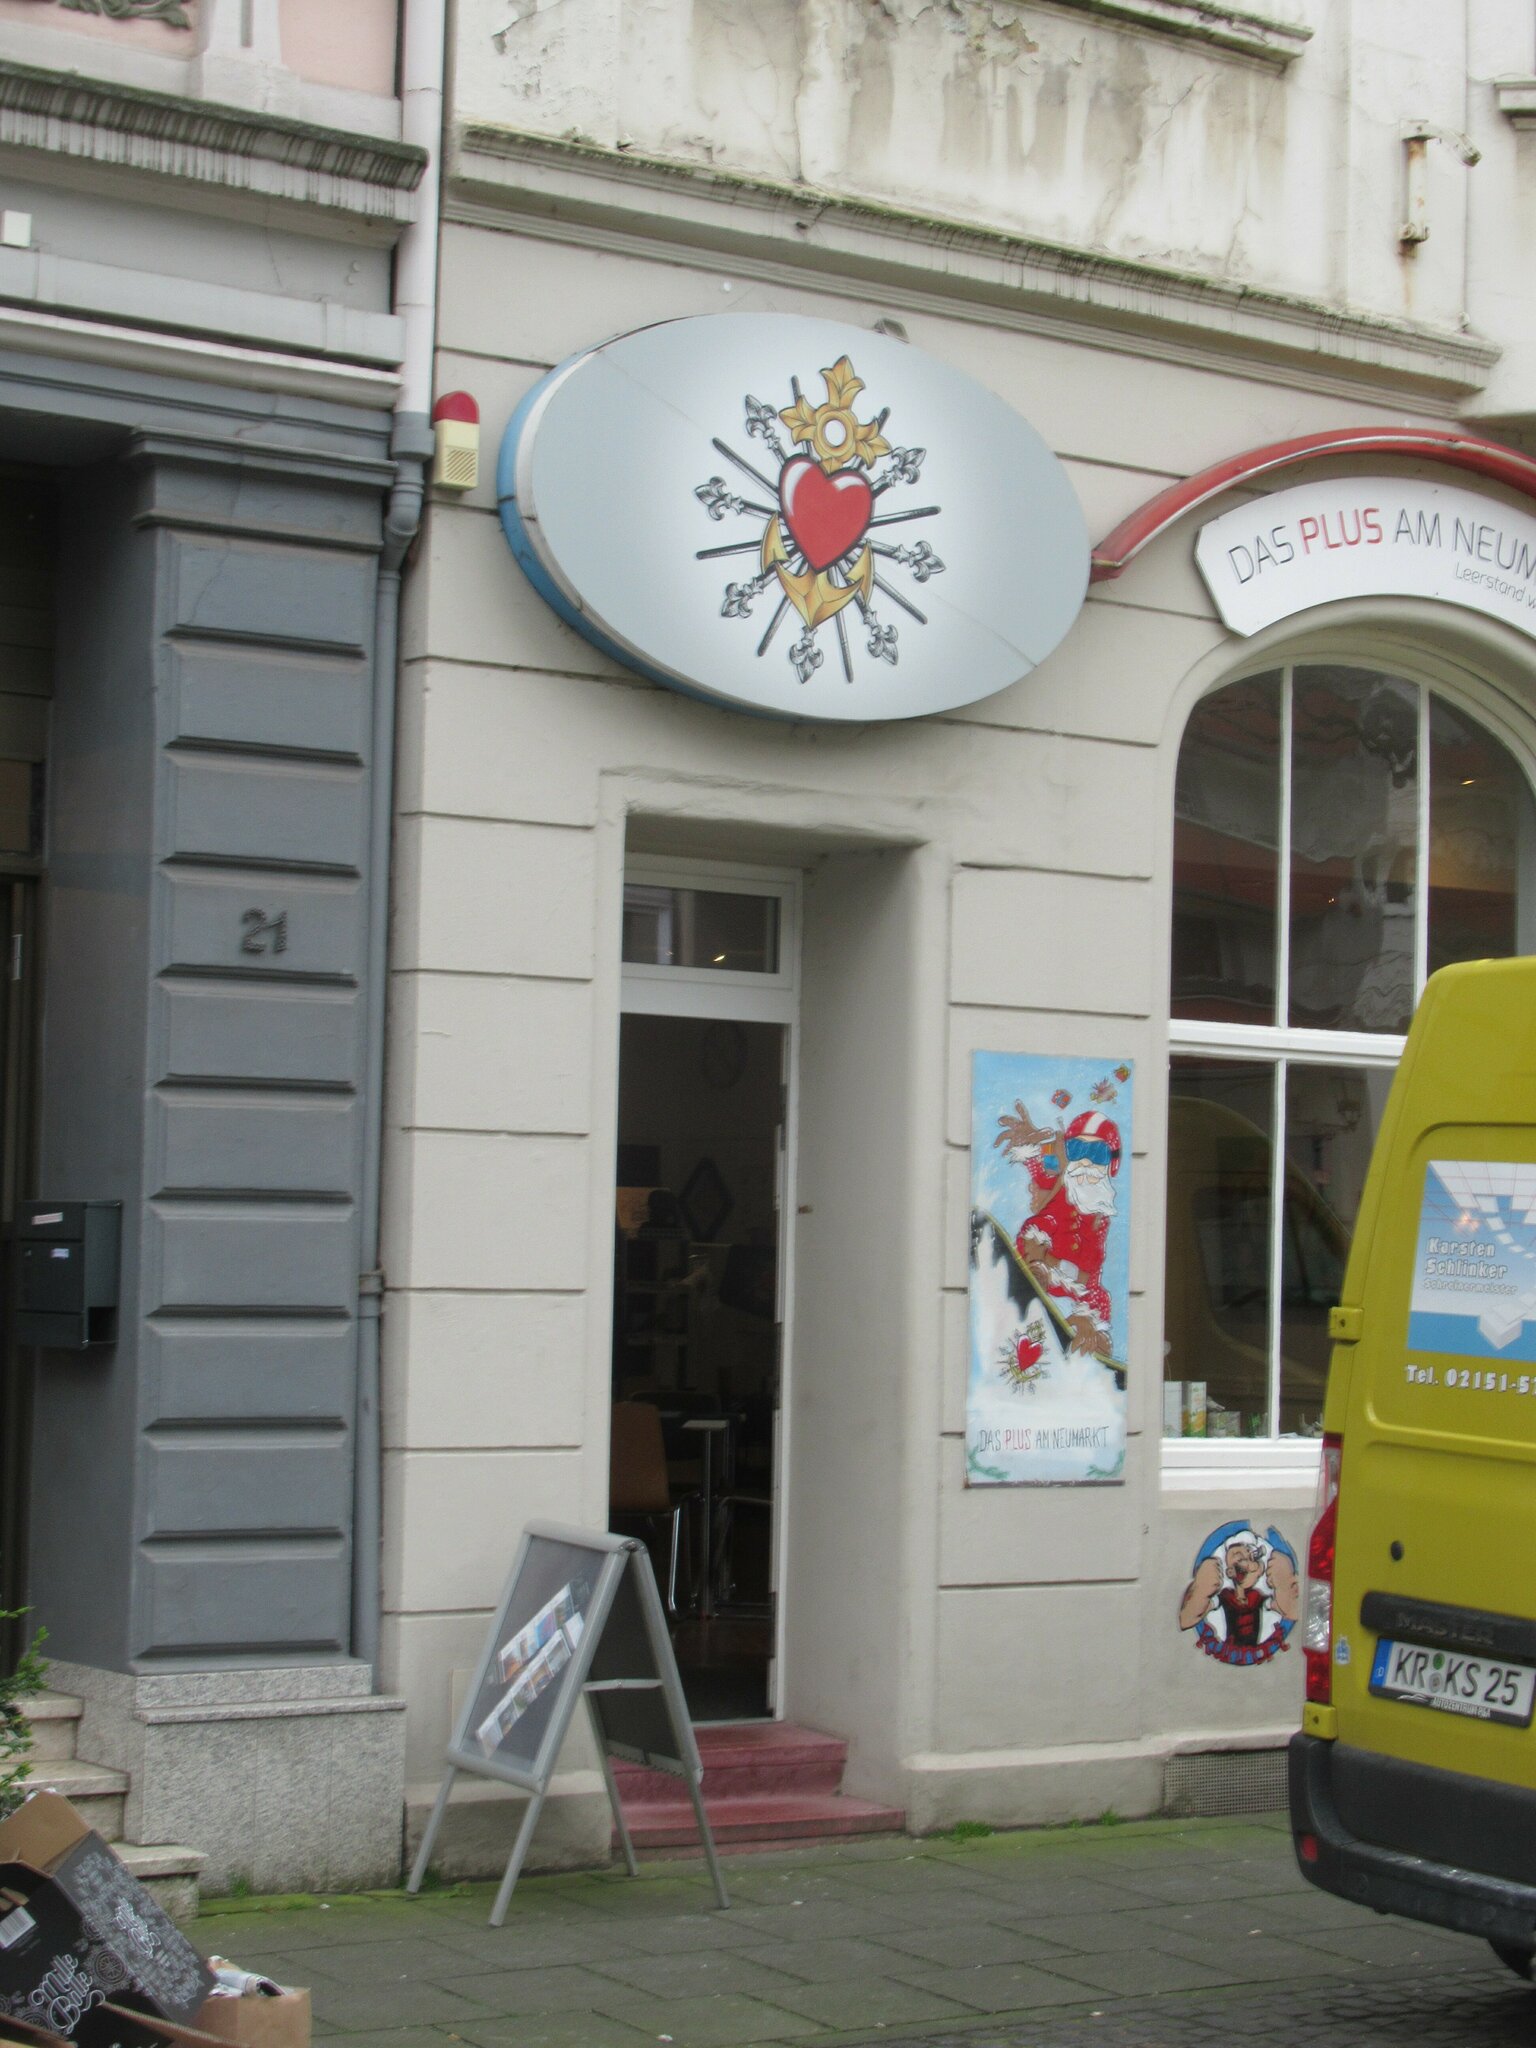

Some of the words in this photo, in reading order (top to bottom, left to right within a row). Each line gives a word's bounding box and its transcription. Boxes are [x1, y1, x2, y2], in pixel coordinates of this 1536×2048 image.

[1228, 525, 1295, 585] DAS
[1299, 507, 1384, 555] PLUS
[1394, 508, 1443, 548] AM
[1455, 561, 1526, 602] Leerstand
[241, 906, 288, 955] 21
[1427, 1237, 1496, 1258] Karsten
[1425, 1257, 1509, 1279] Schlinker
[1406, 1364, 1440, 1386] Tel.
[979, 1429, 1002, 1452] DAS
[1004, 1429, 1032, 1450] PLUS
[1035, 1429, 1050, 1449] AM
[1052, 1426, 1110, 1449] NEUMARKT
[1484, 1667, 1522, 1706] 25
